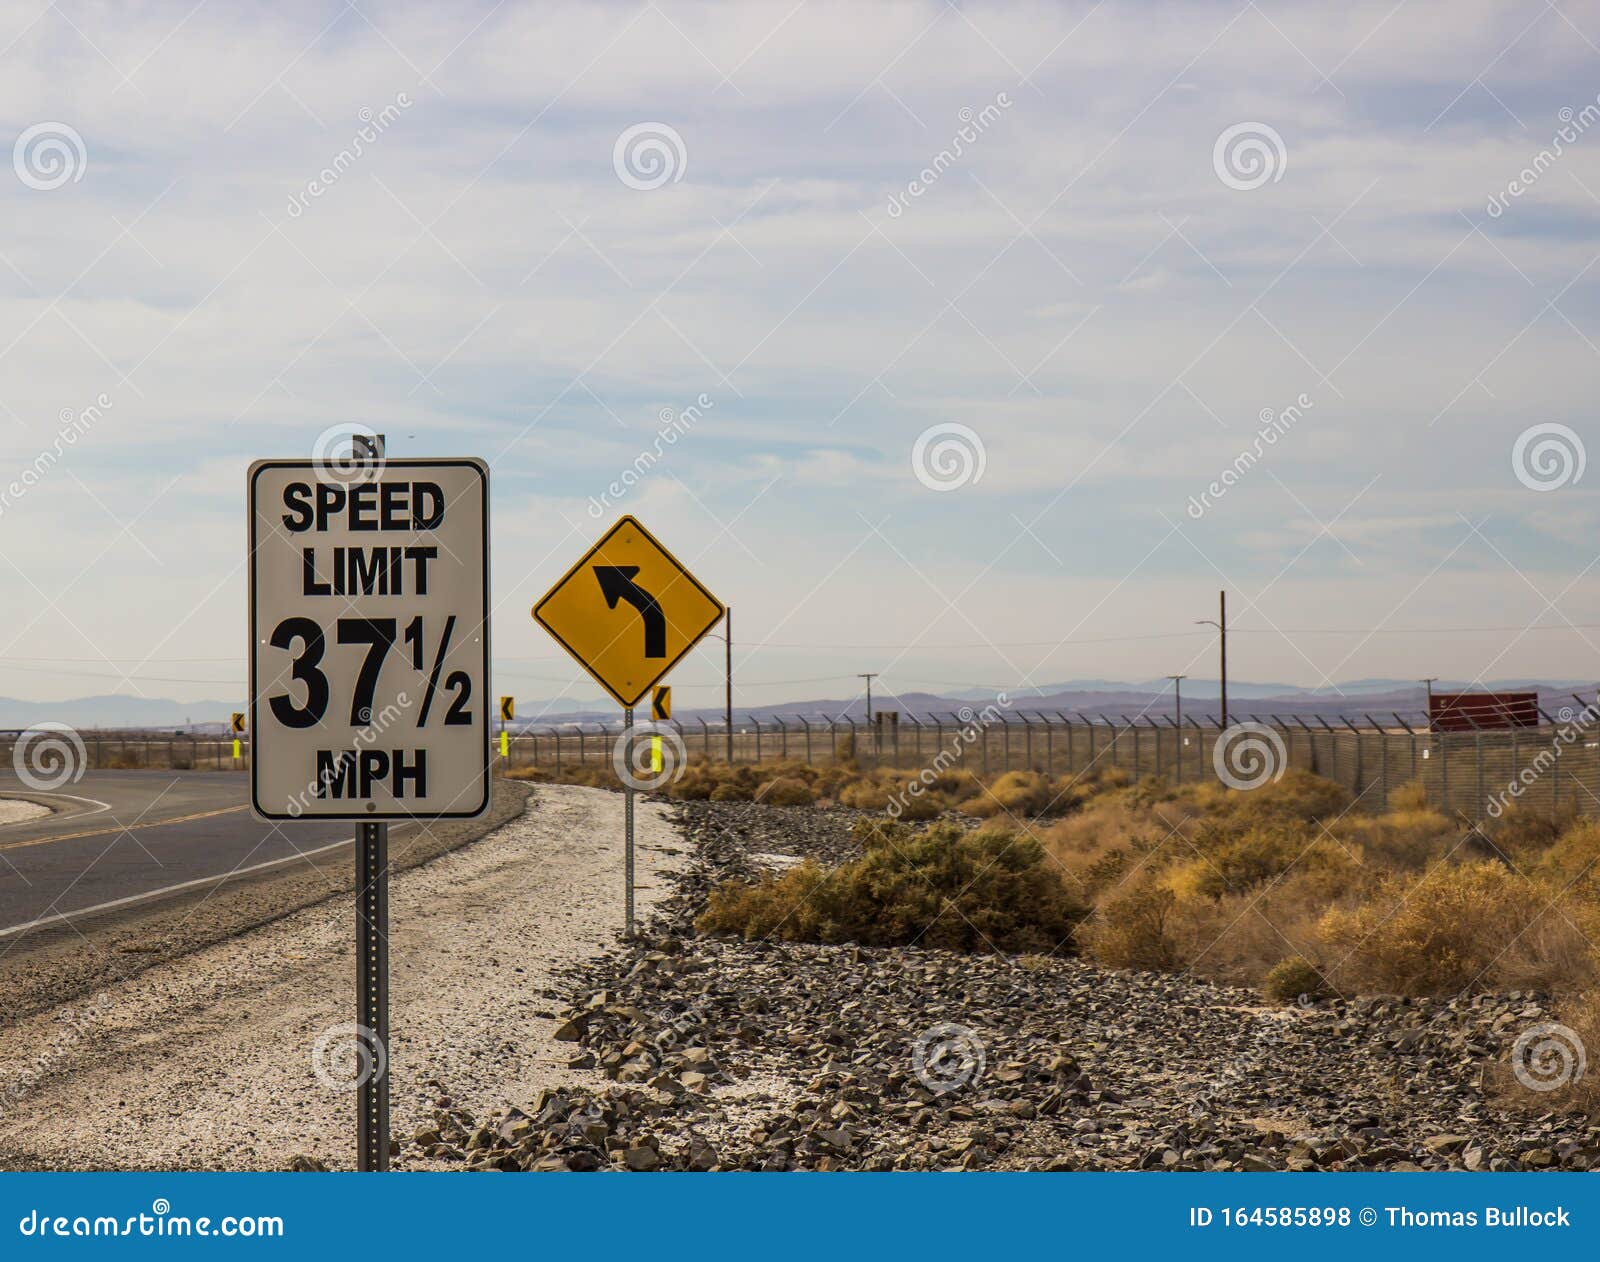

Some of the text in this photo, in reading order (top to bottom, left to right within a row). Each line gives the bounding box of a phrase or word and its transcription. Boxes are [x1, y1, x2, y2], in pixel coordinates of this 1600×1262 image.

[281, 481, 445, 533] SPEED
[303, 546, 438, 596] LIMIT
[316, 748, 427, 800] MPH
